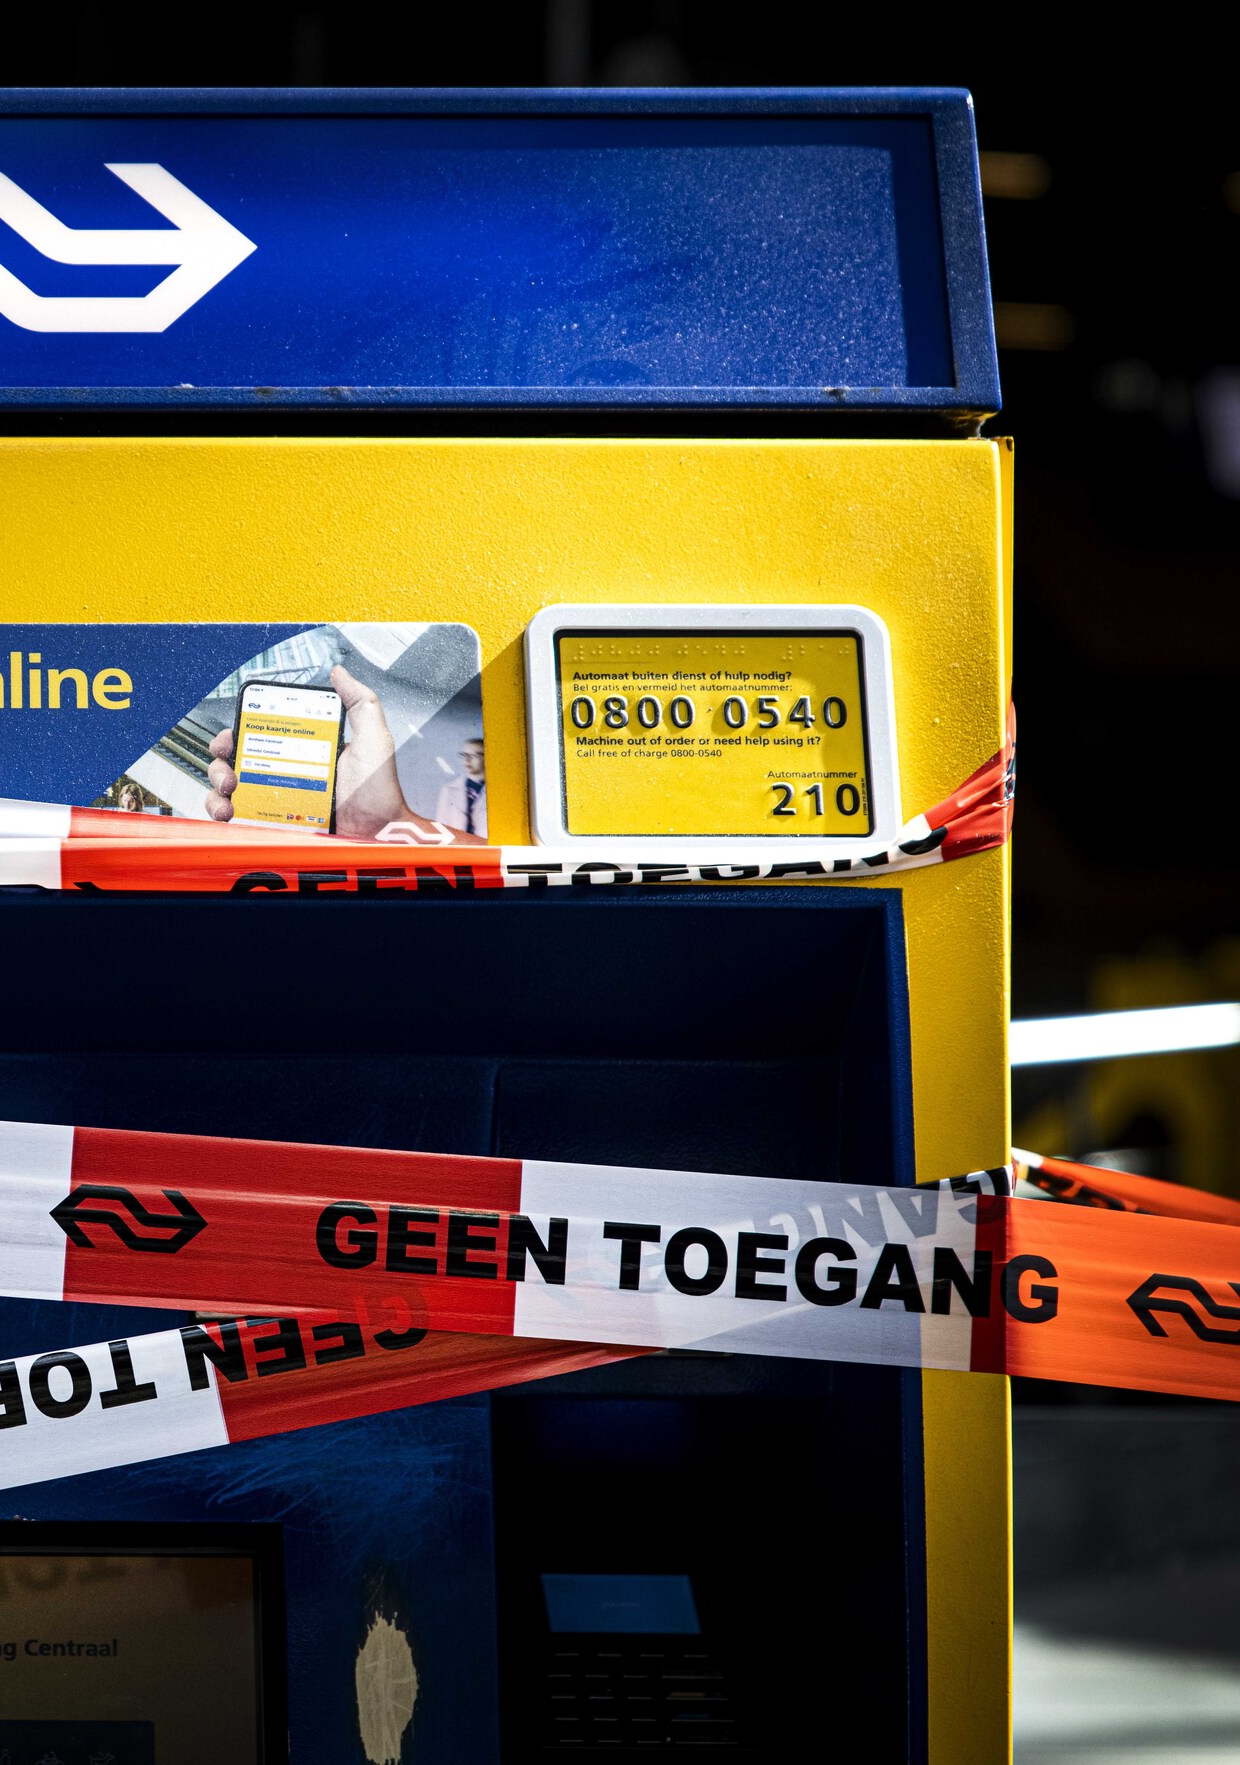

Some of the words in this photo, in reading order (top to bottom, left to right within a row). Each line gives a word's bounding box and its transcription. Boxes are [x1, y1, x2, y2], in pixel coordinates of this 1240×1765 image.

[573, 671, 629, 680] Automaat
[632, 671, 668, 680] buiten
[672, 671, 706, 680] dienst
[710, 671, 722, 680] of
[725, 671, 750, 682] hulp
[754, 671, 792, 682] nodig?
[573, 683, 589, 691] Bel
[591, 683, 620, 693] gratis
[680, 683, 696, 691] het
[700, 684, 793, 692] automaatnummer:
[571, 694, 695, 729] 0800
[723, 694, 847, 729] 0540
[576, 736, 623, 745] Machine
[627, 737, 646, 745] out
[650, 736, 662, 745] of
[665, 736, 695, 745] order
[714, 736, 741, 745] need
[745, 736, 769, 747] help
[773, 736, 804, 747] using
[807, 736, 821, 745] it?
[577, 749, 594, 757] Call
[598, 749, 617, 757] free
[621, 749, 632, 757] of
[634, 749, 668, 759] charge
[671, 749, 722, 757] 0800-0540
[768, 769, 857, 779] Automaatnummer
[771, 782, 860, 816] 210
[315, 1200, 569, 1286] GEEN
[604, 1221, 1059, 1323] TOEGANG
[24, 1636, 118, 1657] Centraal
